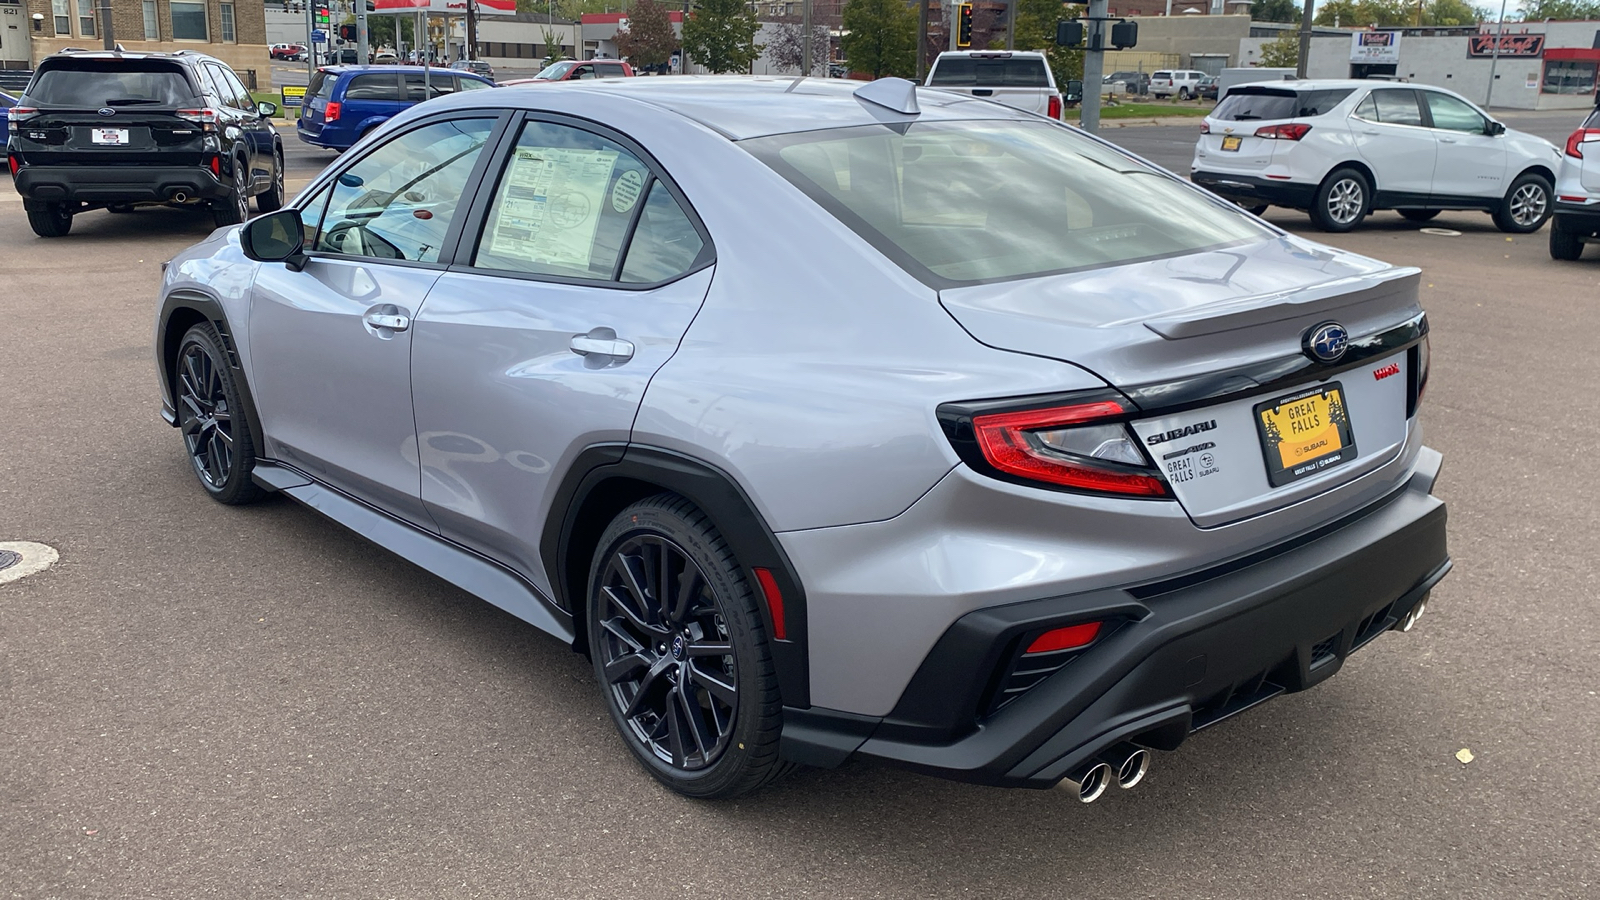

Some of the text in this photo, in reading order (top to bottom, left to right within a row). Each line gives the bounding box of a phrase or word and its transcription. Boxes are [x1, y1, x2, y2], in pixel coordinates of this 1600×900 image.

[1373, 363, 1399, 381] WRX
[1288, 401, 1317, 420] GREAT
[1147, 419, 1218, 446] SUBARU
[1291, 414, 1320, 435] FALLS
[1185, 441, 1217, 455] AWD
[1303, 439, 1328, 453] SUBARU
[1167, 458, 1191, 473] GREAT
[1199, 467, 1220, 478] SUBARU
[1294, 455, 1341, 476] GREAT FALLS SUBARU
[1169, 469, 1194, 485] FALLS
[703, 552, 734, 603] SPORT
